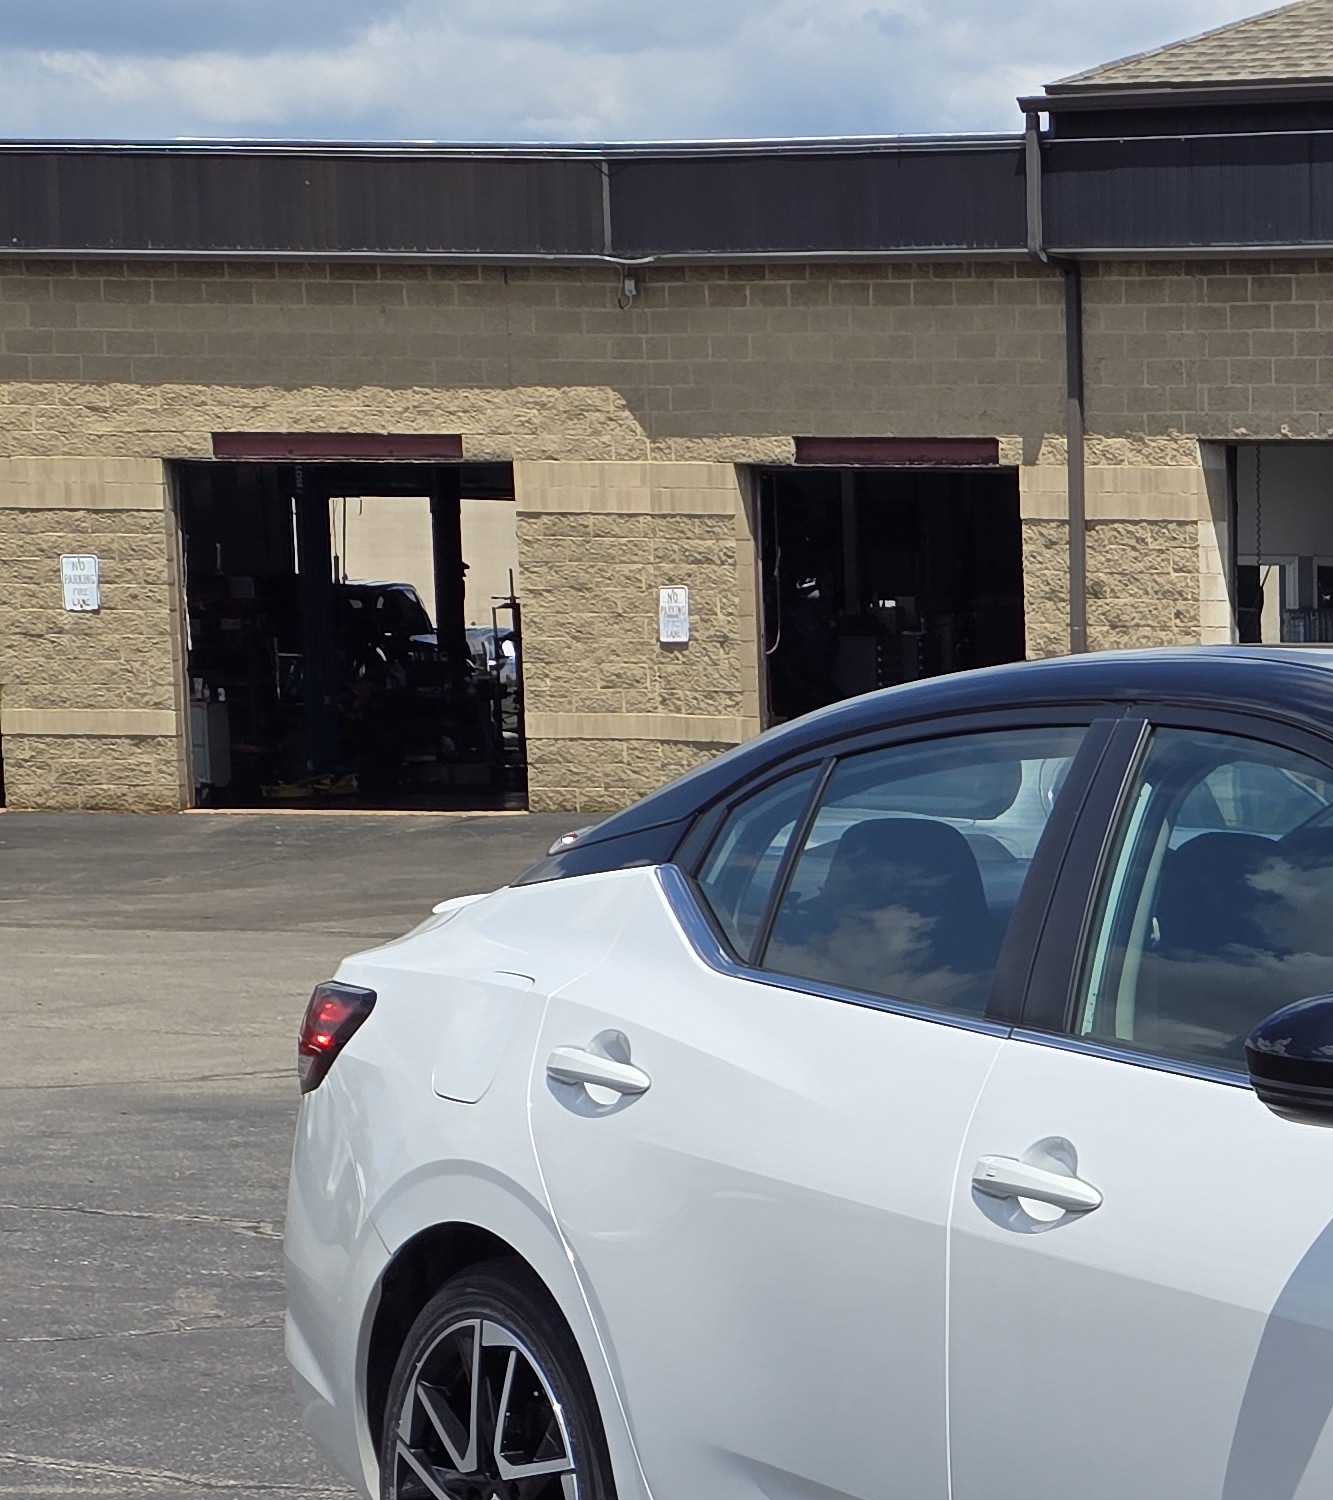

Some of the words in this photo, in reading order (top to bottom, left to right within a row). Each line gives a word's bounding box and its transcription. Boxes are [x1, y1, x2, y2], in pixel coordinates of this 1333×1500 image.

[71, 560, 86, 572] NO
[64, 574, 96, 585] PARKING
[667, 591, 679, 604] NO
